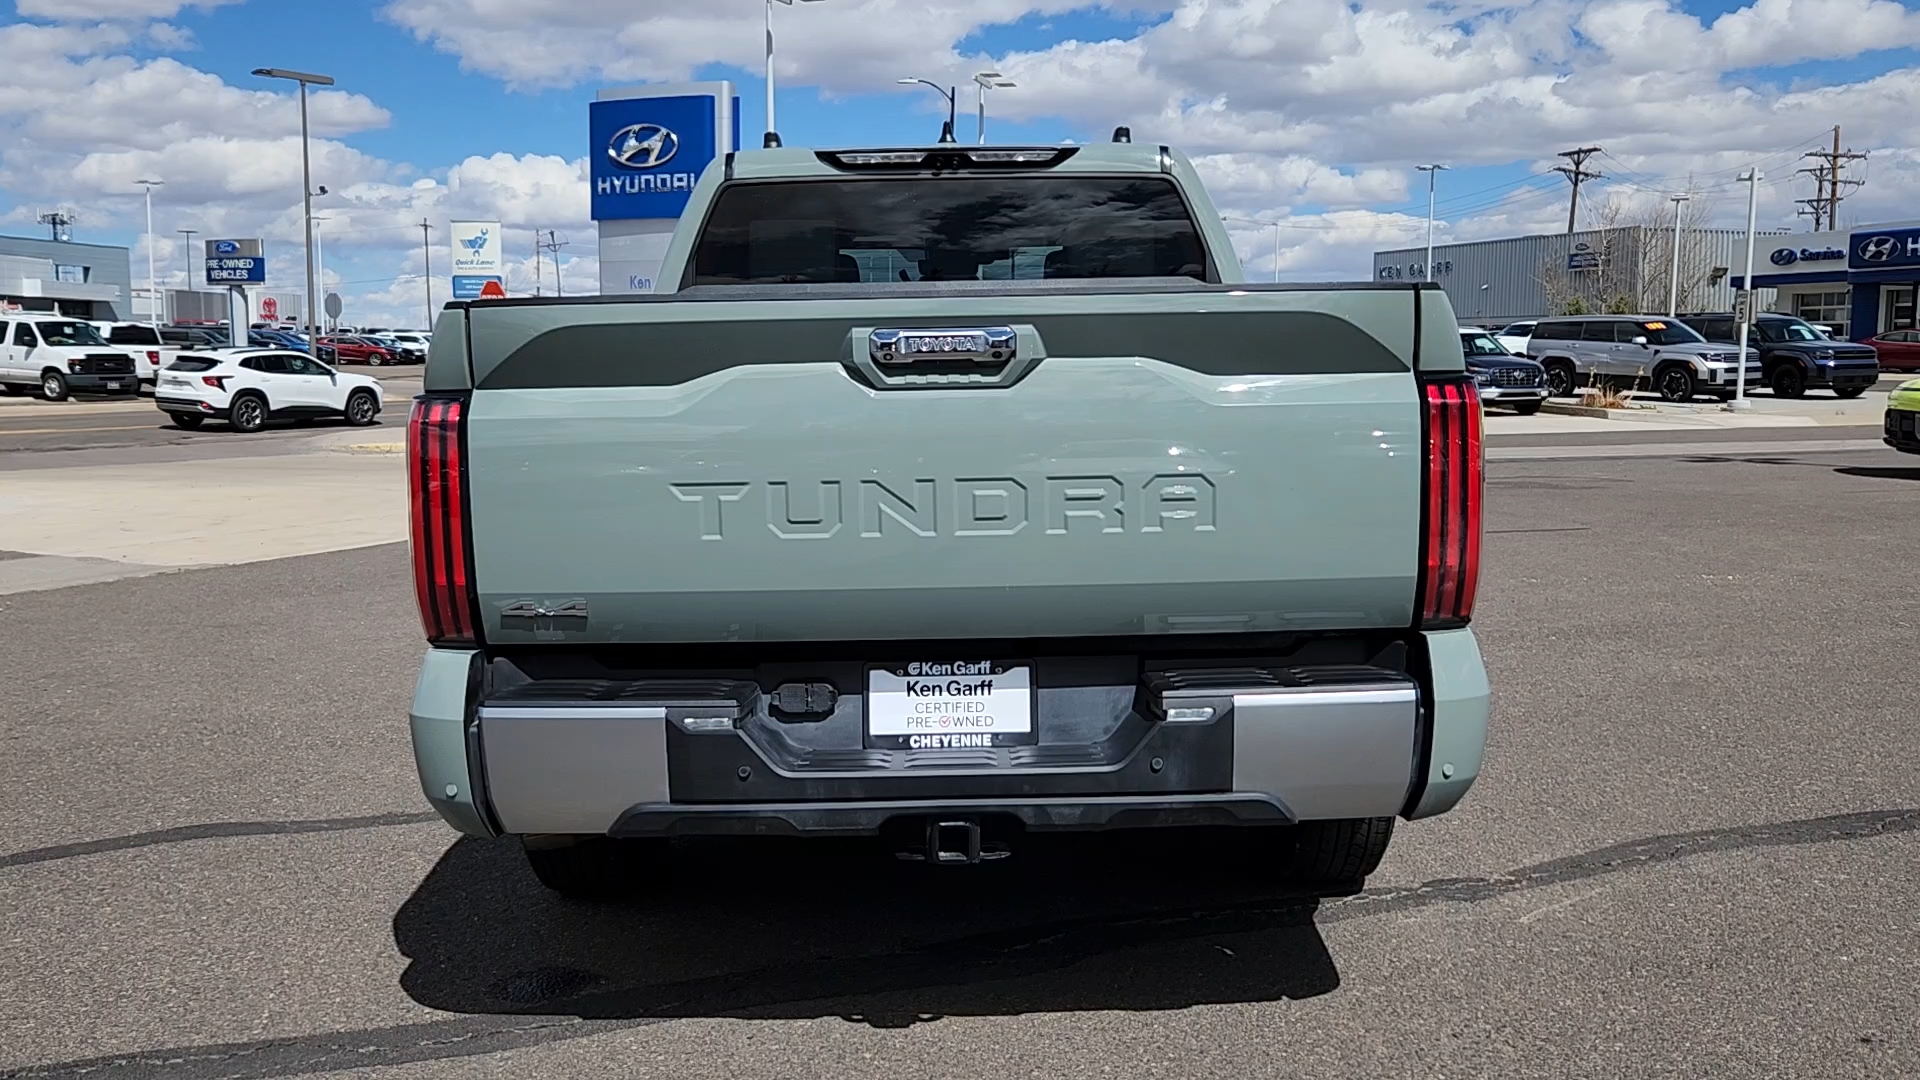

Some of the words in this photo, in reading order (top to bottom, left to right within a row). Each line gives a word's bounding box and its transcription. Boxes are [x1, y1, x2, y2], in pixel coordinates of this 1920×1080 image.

[597, 173, 696, 195] HYUNDAI
[206, 258, 254, 269] PRE-OWNED
[455, 258, 475, 266] Quick
[476, 258, 495, 266] Lane
[210, 269, 249, 279] VEHICLES
[1379, 264, 1403, 279] KEN
[629, 275, 652, 290] Ken
[1738, 307, 1744, 320] 5
[908, 336, 977, 351] TOYOTA
[669, 473, 1217, 540] TUNDRA
[921, 662, 951, 675] Ken
[953, 660, 992, 675] Garff
[906, 680, 943, 698] Ken
[946, 679, 994, 697] Garff
[914, 702, 985, 714] CERTIFIED
[909, 734, 993, 748] CHEYENNE
